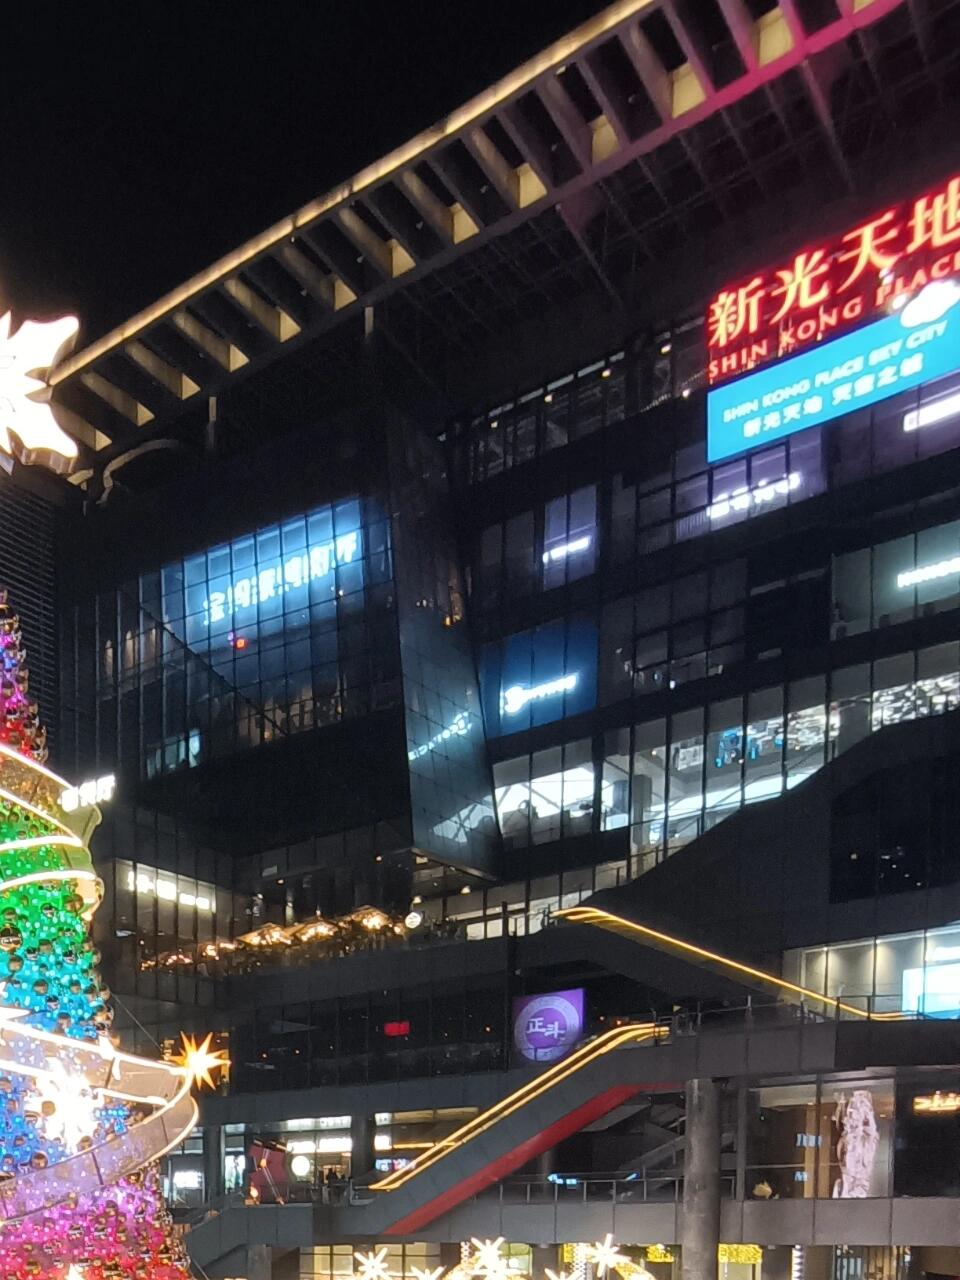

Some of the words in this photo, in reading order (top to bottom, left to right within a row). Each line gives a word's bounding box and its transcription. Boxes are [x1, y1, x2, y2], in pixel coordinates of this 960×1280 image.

[707, 174, 960, 347] 新光天地
[708, 340, 768, 382] SHIN
[782, 301, 862, 348] KONG
